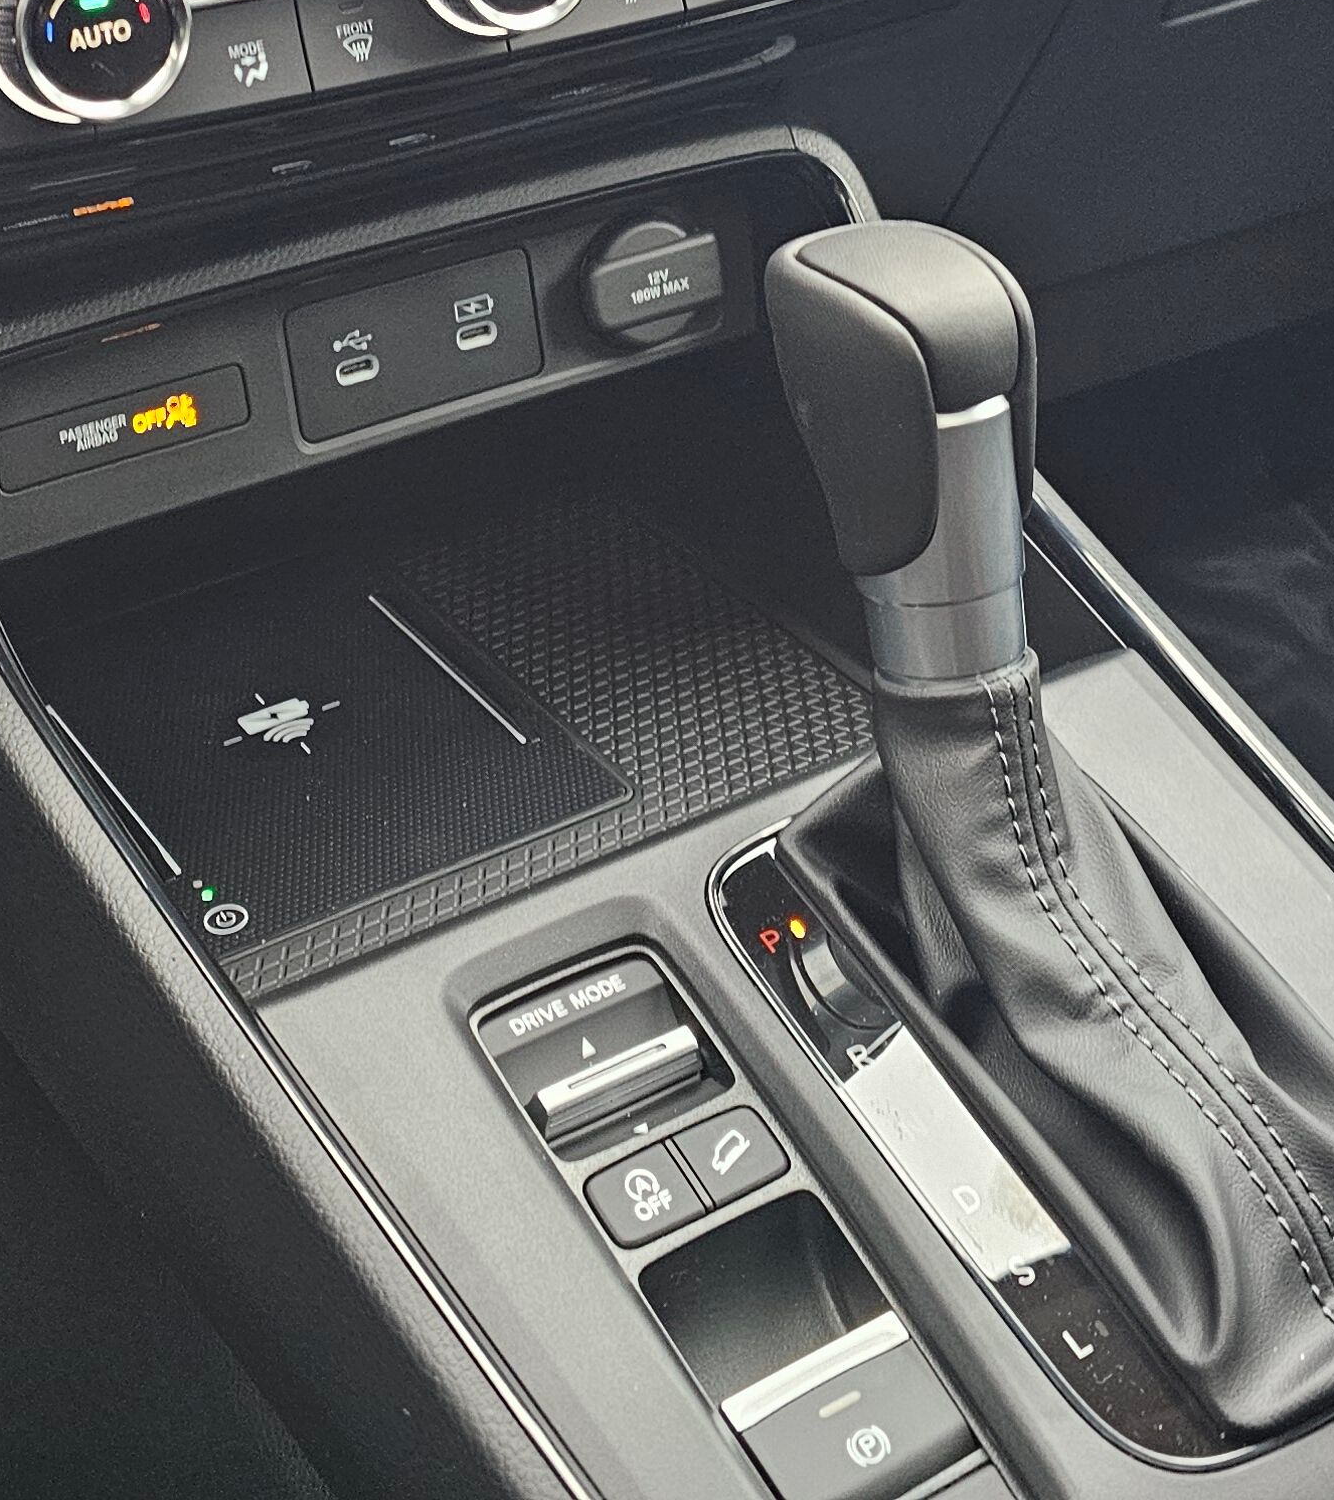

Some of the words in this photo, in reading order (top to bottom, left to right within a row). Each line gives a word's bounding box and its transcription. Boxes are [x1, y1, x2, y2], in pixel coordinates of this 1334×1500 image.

[70, 18, 132, 53] AUTO
[335, 18, 374, 39] FRONT
[228, 38, 264, 59] MODE
[662, 276, 690, 296] MAX
[59, 413, 127, 445] PASSENGER
[132, 406, 166, 434] OFF
[759, 929, 780, 954] P
[508, 999, 569, 1037] DRIVE
[569, 973, 627, 1010] MODE
[634, 1188, 673, 1222] OFF
[952, 1185, 980, 1215] D
[1008, 1255, 1036, 1286] S
[1062, 1330, 1095, 1360] L
